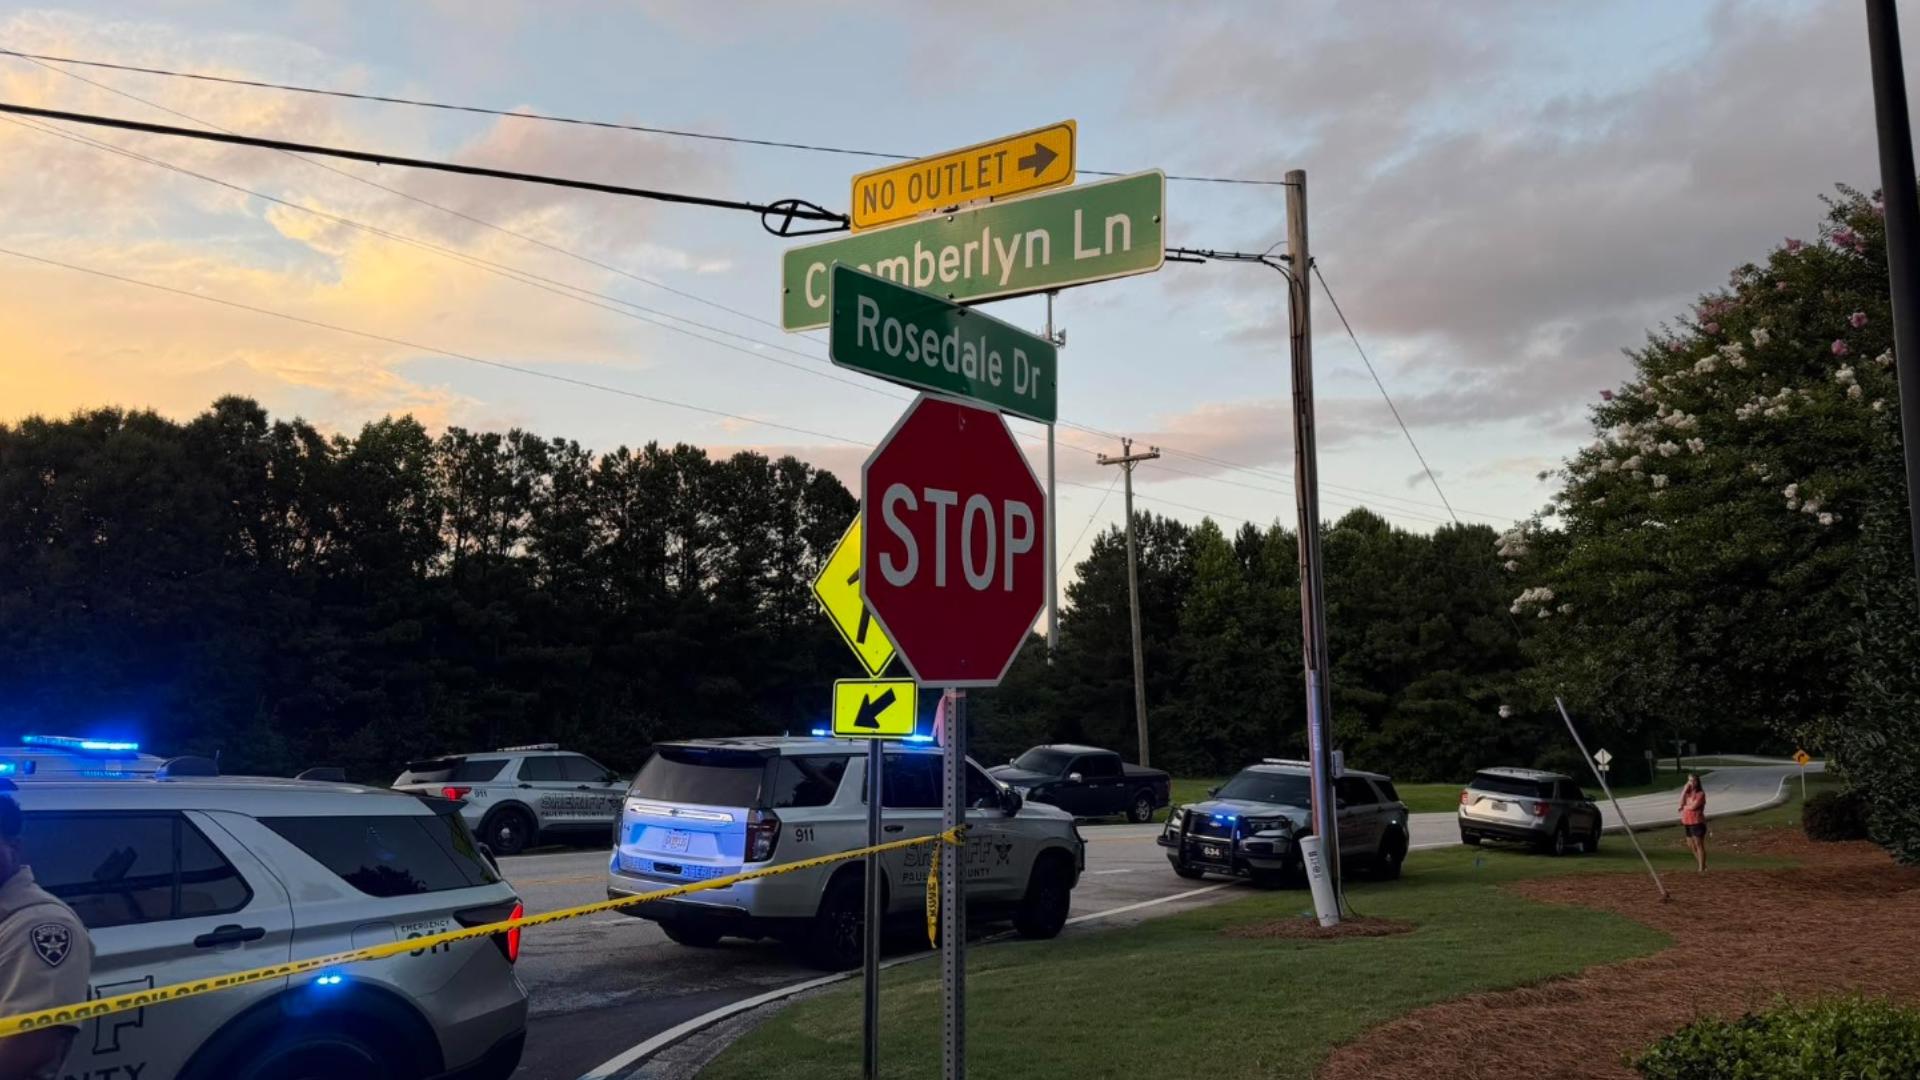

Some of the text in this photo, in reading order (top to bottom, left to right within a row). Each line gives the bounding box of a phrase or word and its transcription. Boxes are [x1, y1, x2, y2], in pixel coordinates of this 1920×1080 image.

[863, 151, 1007, 215] NO OUTLET
[804, 209, 1131, 309] Cmberlyn Ln
[857, 293, 1041, 399] Rosedale Dr
[879, 482, 1035, 592] STOP
[795, 828, 814, 842] 911
